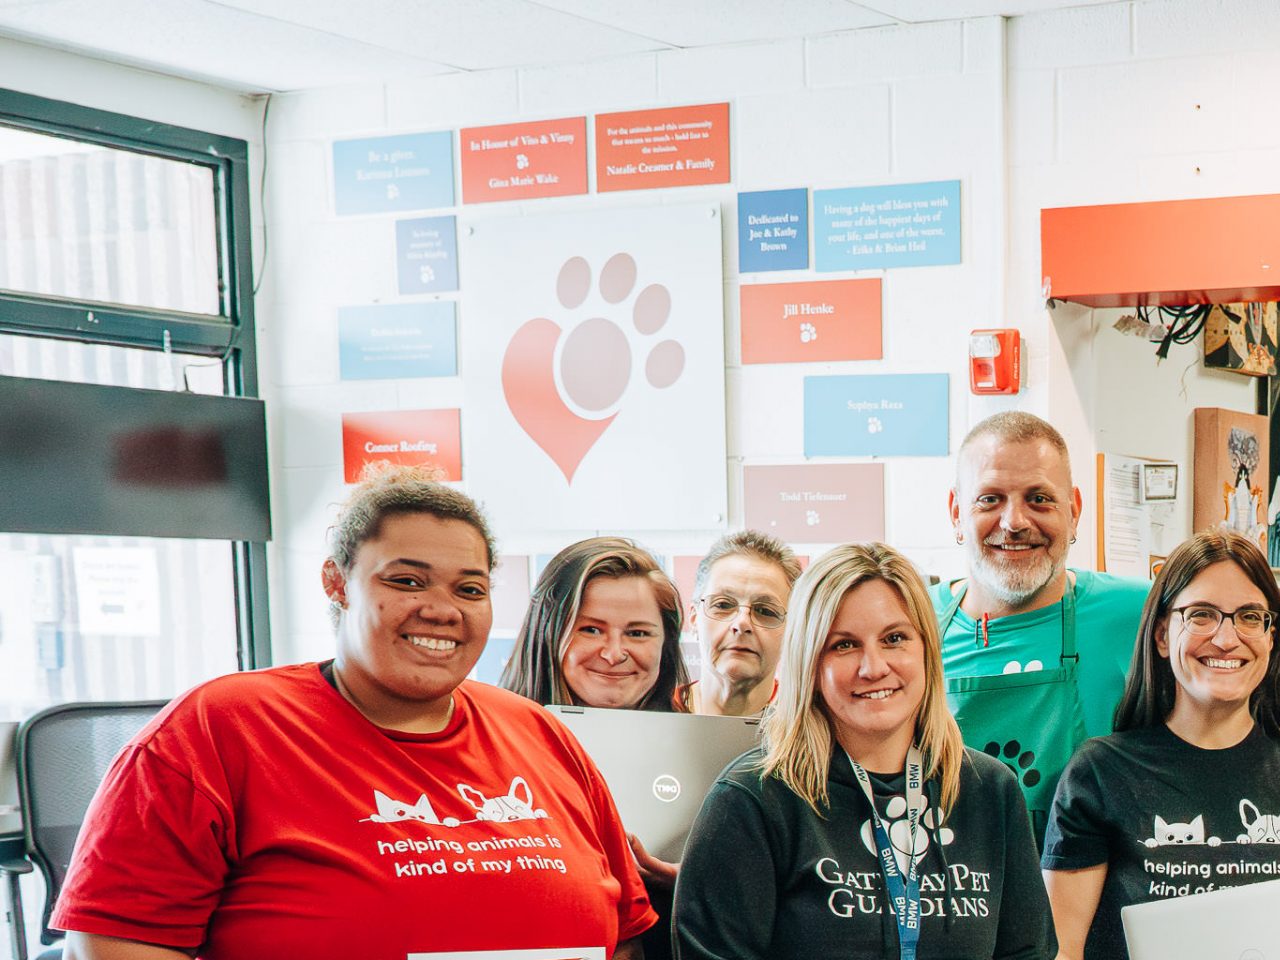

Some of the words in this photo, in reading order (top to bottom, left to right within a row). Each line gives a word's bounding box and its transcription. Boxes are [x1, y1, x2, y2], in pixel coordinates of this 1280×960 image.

[470, 141, 480, 151] In
[510, 137, 518, 147] of
[540, 135, 548, 144] &
[607, 164, 637, 176] Natalie
[638, 162, 673, 173] Creamer
[676, 160, 684, 170] &
[686, 158, 715, 171] Family
[511, 176, 533, 186] Marie
[825, 204, 853, 215] Having
[860, 202, 876, 214] dog
[878, 201, 891, 211] will
[914, 202, 929, 211] you
[930, 196, 949, 208] with
[748, 214, 788, 225] Dedicated
[790, 214, 799, 222] to
[879, 213, 911, 228] happiest
[913, 213, 931, 225] days
[932, 210, 942, 221] of
[749, 229, 762, 240] Joe
[764, 228, 772, 237] &
[863, 229, 878, 240] and
[875, 244, 882, 253] &
[783, 304, 798, 318] Jill
[800, 303, 835, 315] Henke
[908, 764, 920, 789] BMW
[377, 837, 465, 855] helping
[467, 835, 546, 852] animals
[547, 834, 562, 849] is
[394, 859, 448, 877] kind
[453, 858, 475, 873] of
[481, 857, 512, 874] my
[516, 855, 567, 874] thing
[881, 847, 899, 877] BMW
[1144, 859, 1211, 878] helping
[816, 857, 946, 892] GATAY
[948, 864, 990, 894] PET
[1149, 881, 1190, 897] kind
[828, 889, 989, 918] GUDIANS
[907, 899, 919, 930] BMW
